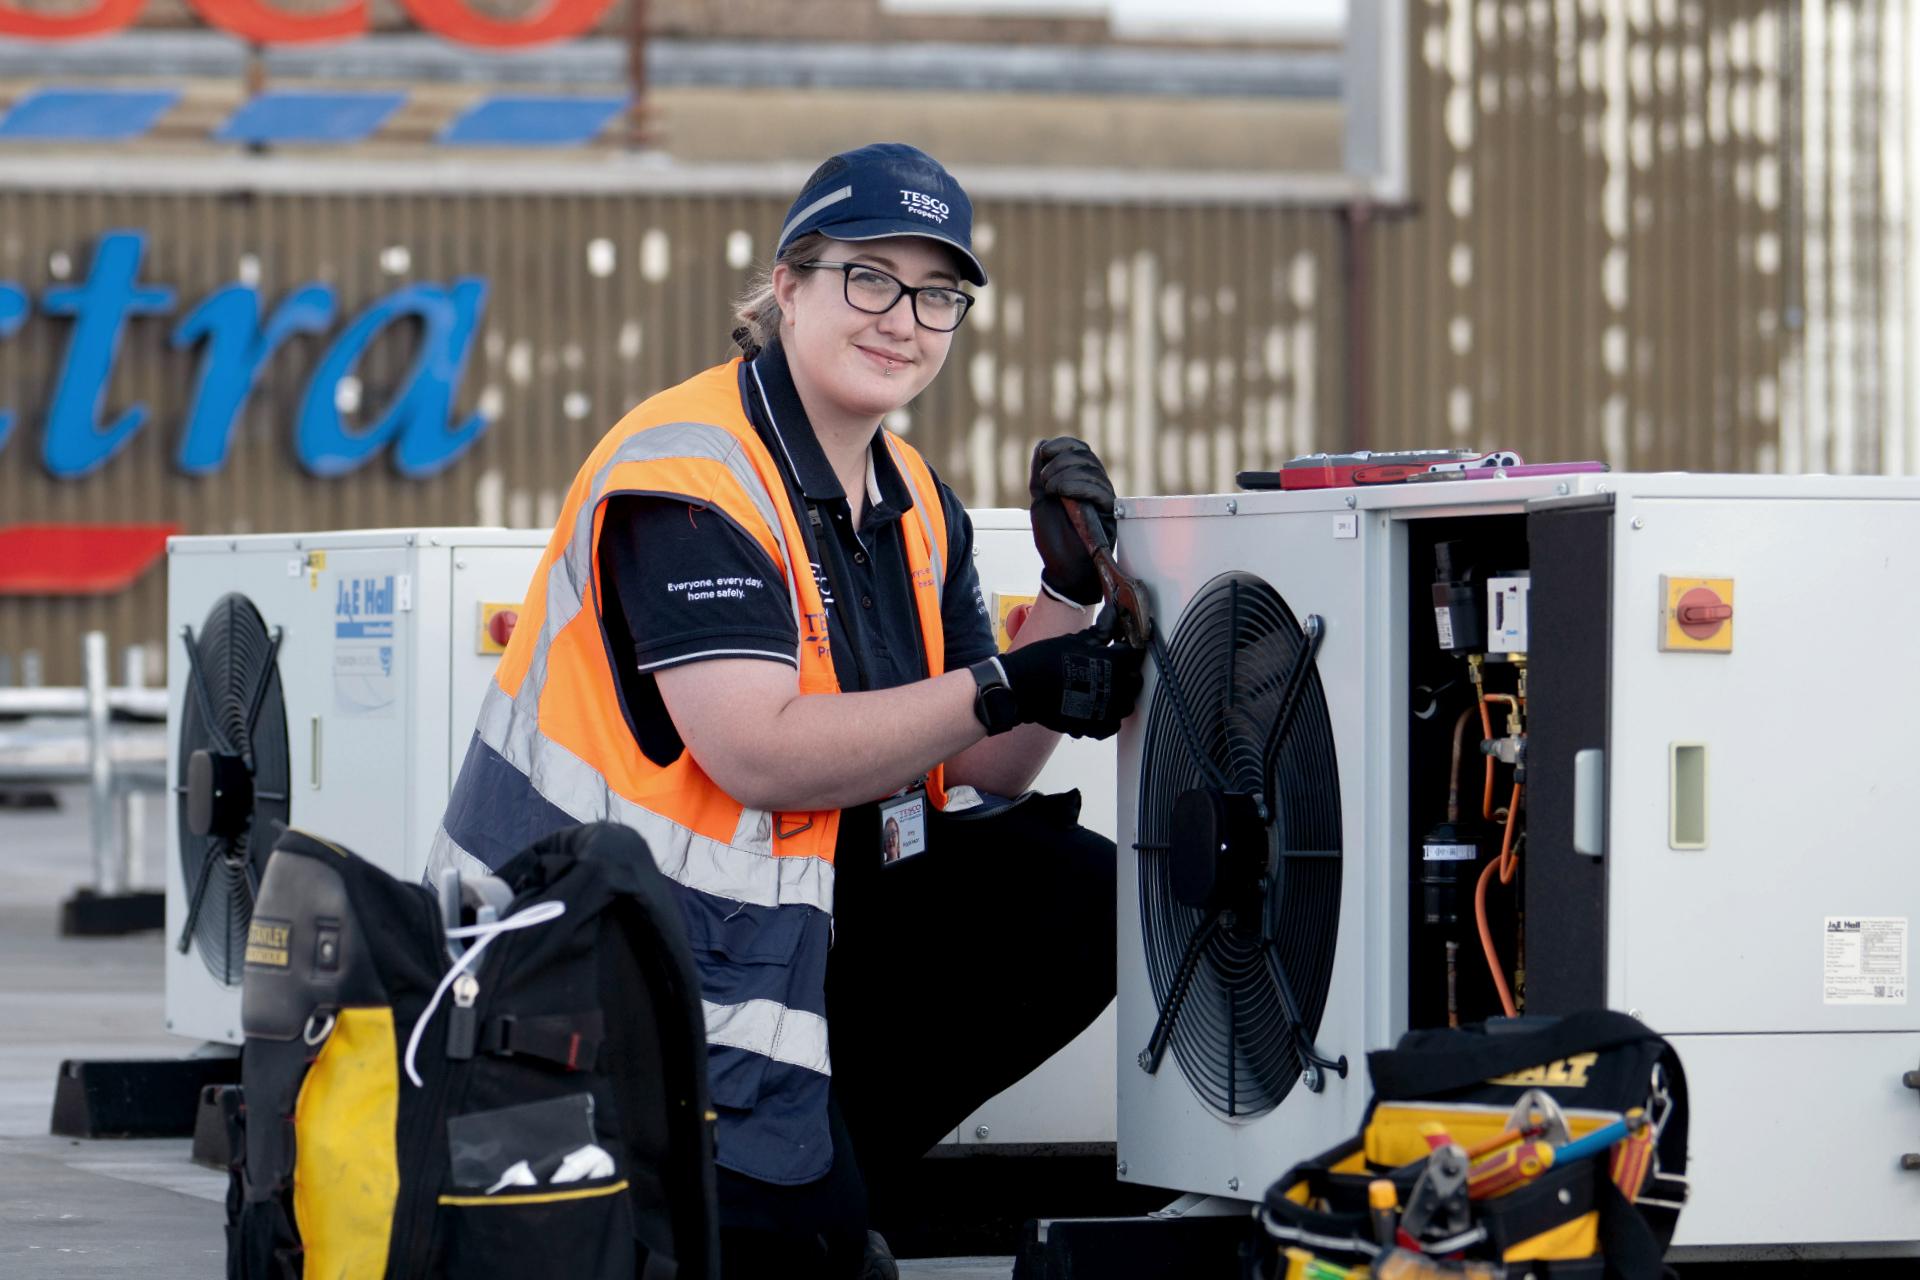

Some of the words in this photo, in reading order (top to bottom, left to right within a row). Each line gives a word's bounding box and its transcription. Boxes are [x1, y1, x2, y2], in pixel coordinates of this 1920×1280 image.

[900, 190, 949, 214] TESCO
[908, 206, 942, 224] Property
[0, 228, 491, 479] tra
[667, 579, 714, 592] Everyone,
[716, 577, 744, 587] every
[745, 577, 764, 589] day,
[687, 591, 715, 601] home
[716, 588, 746, 600] safely.
[364, 576, 394, 615] Hall
